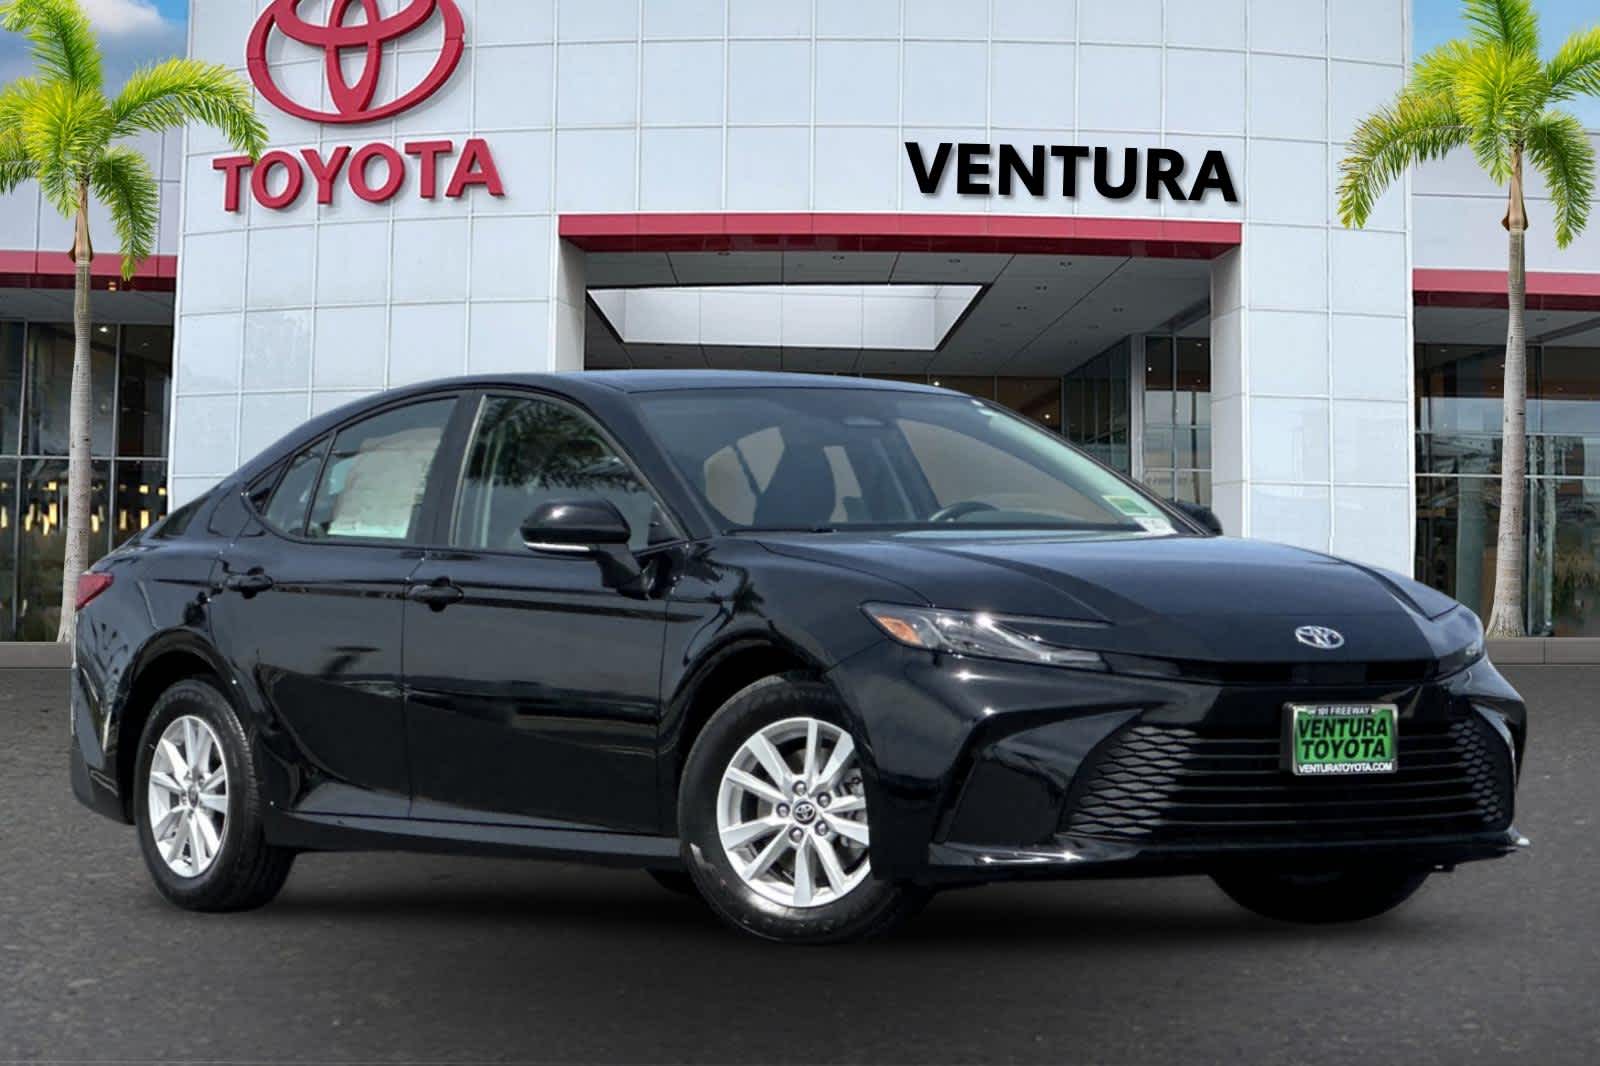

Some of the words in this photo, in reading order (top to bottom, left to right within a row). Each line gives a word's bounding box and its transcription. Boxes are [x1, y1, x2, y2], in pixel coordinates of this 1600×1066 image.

[213, 139, 504, 212] TOYOTA
[905, 142, 1238, 202] VENTURA
[1330, 706, 1369, 714] FREEWAY
[1299, 718, 1388, 738] VENTURA
[1302, 739, 1386, 759] TOYOTA
[1298, 762, 1393, 773] VENTURATOYOTA.COM
